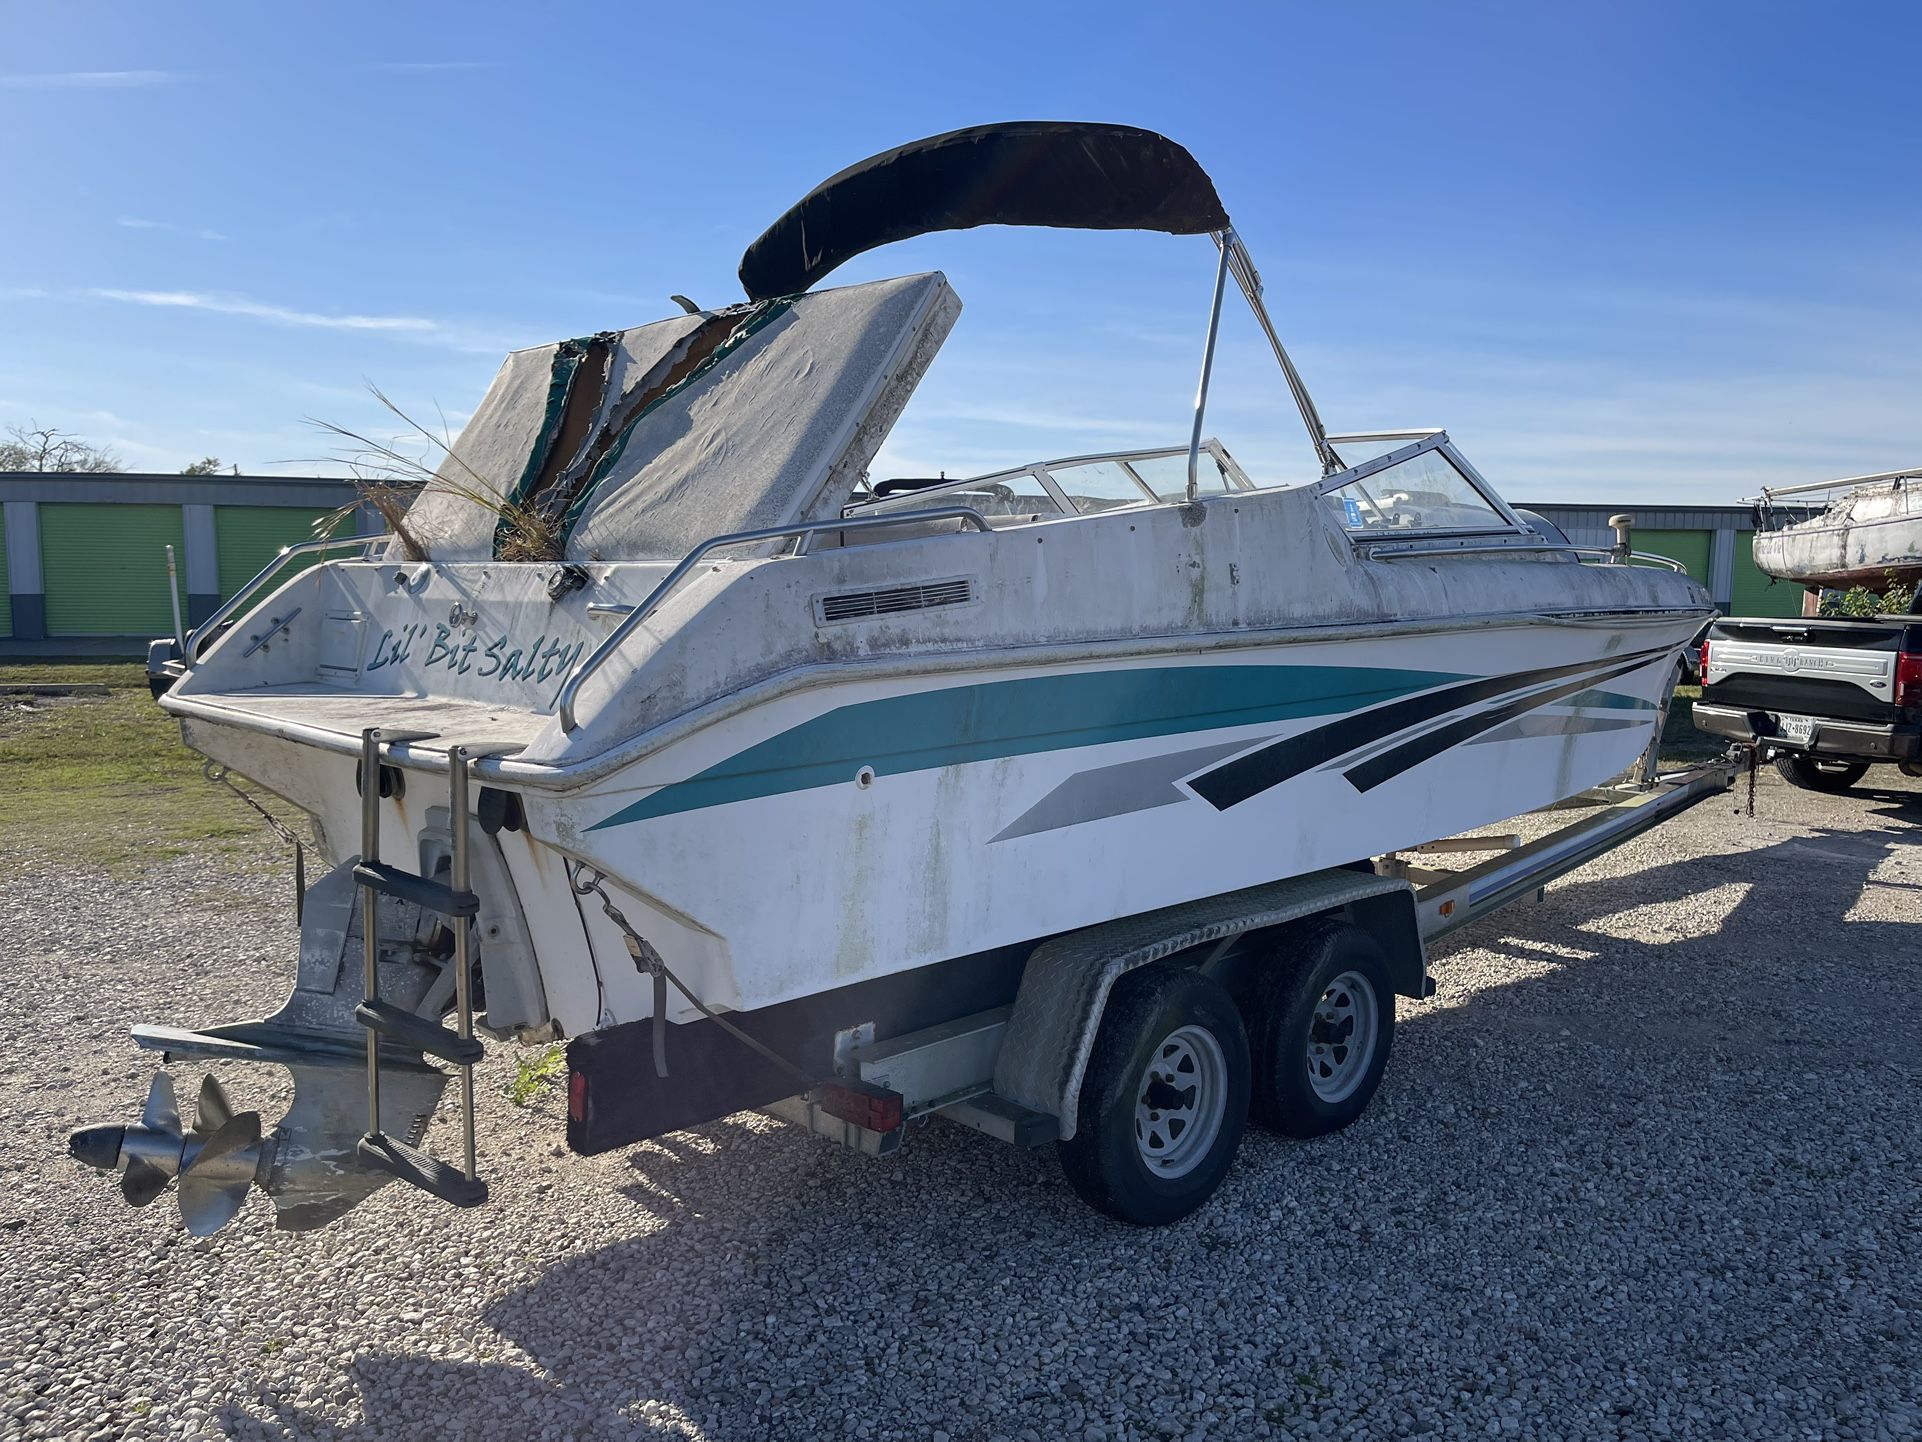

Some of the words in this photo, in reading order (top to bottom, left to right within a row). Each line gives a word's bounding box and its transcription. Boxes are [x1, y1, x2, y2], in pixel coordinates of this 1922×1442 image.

[366, 623, 427, 671] Lil'
[424, 622, 477, 675] Bit
[477, 634, 584, 710] Salty
